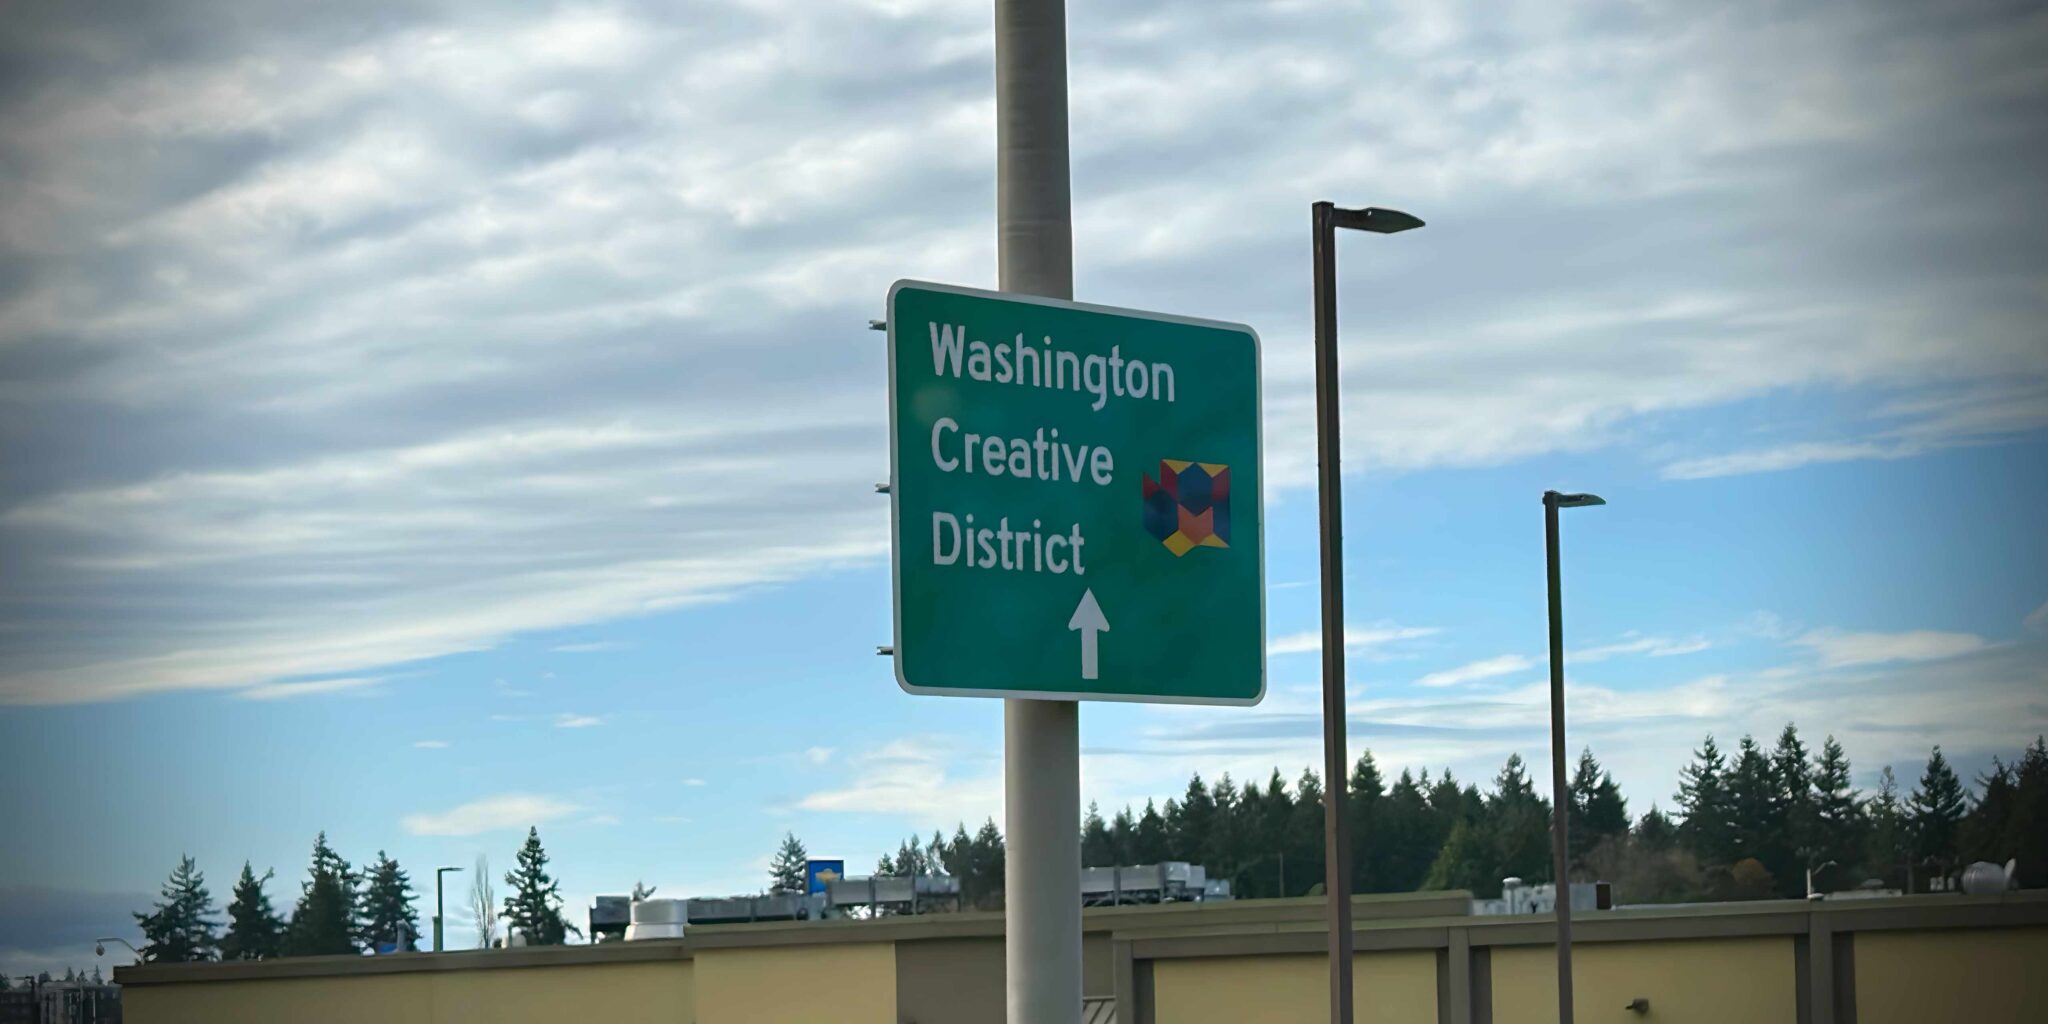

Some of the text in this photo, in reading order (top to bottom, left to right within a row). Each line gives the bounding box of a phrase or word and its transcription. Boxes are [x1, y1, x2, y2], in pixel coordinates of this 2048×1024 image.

[929, 321, 1175, 411] Washington
[931, 417, 1114, 486] Creative
[932, 511, 1085, 575] District
